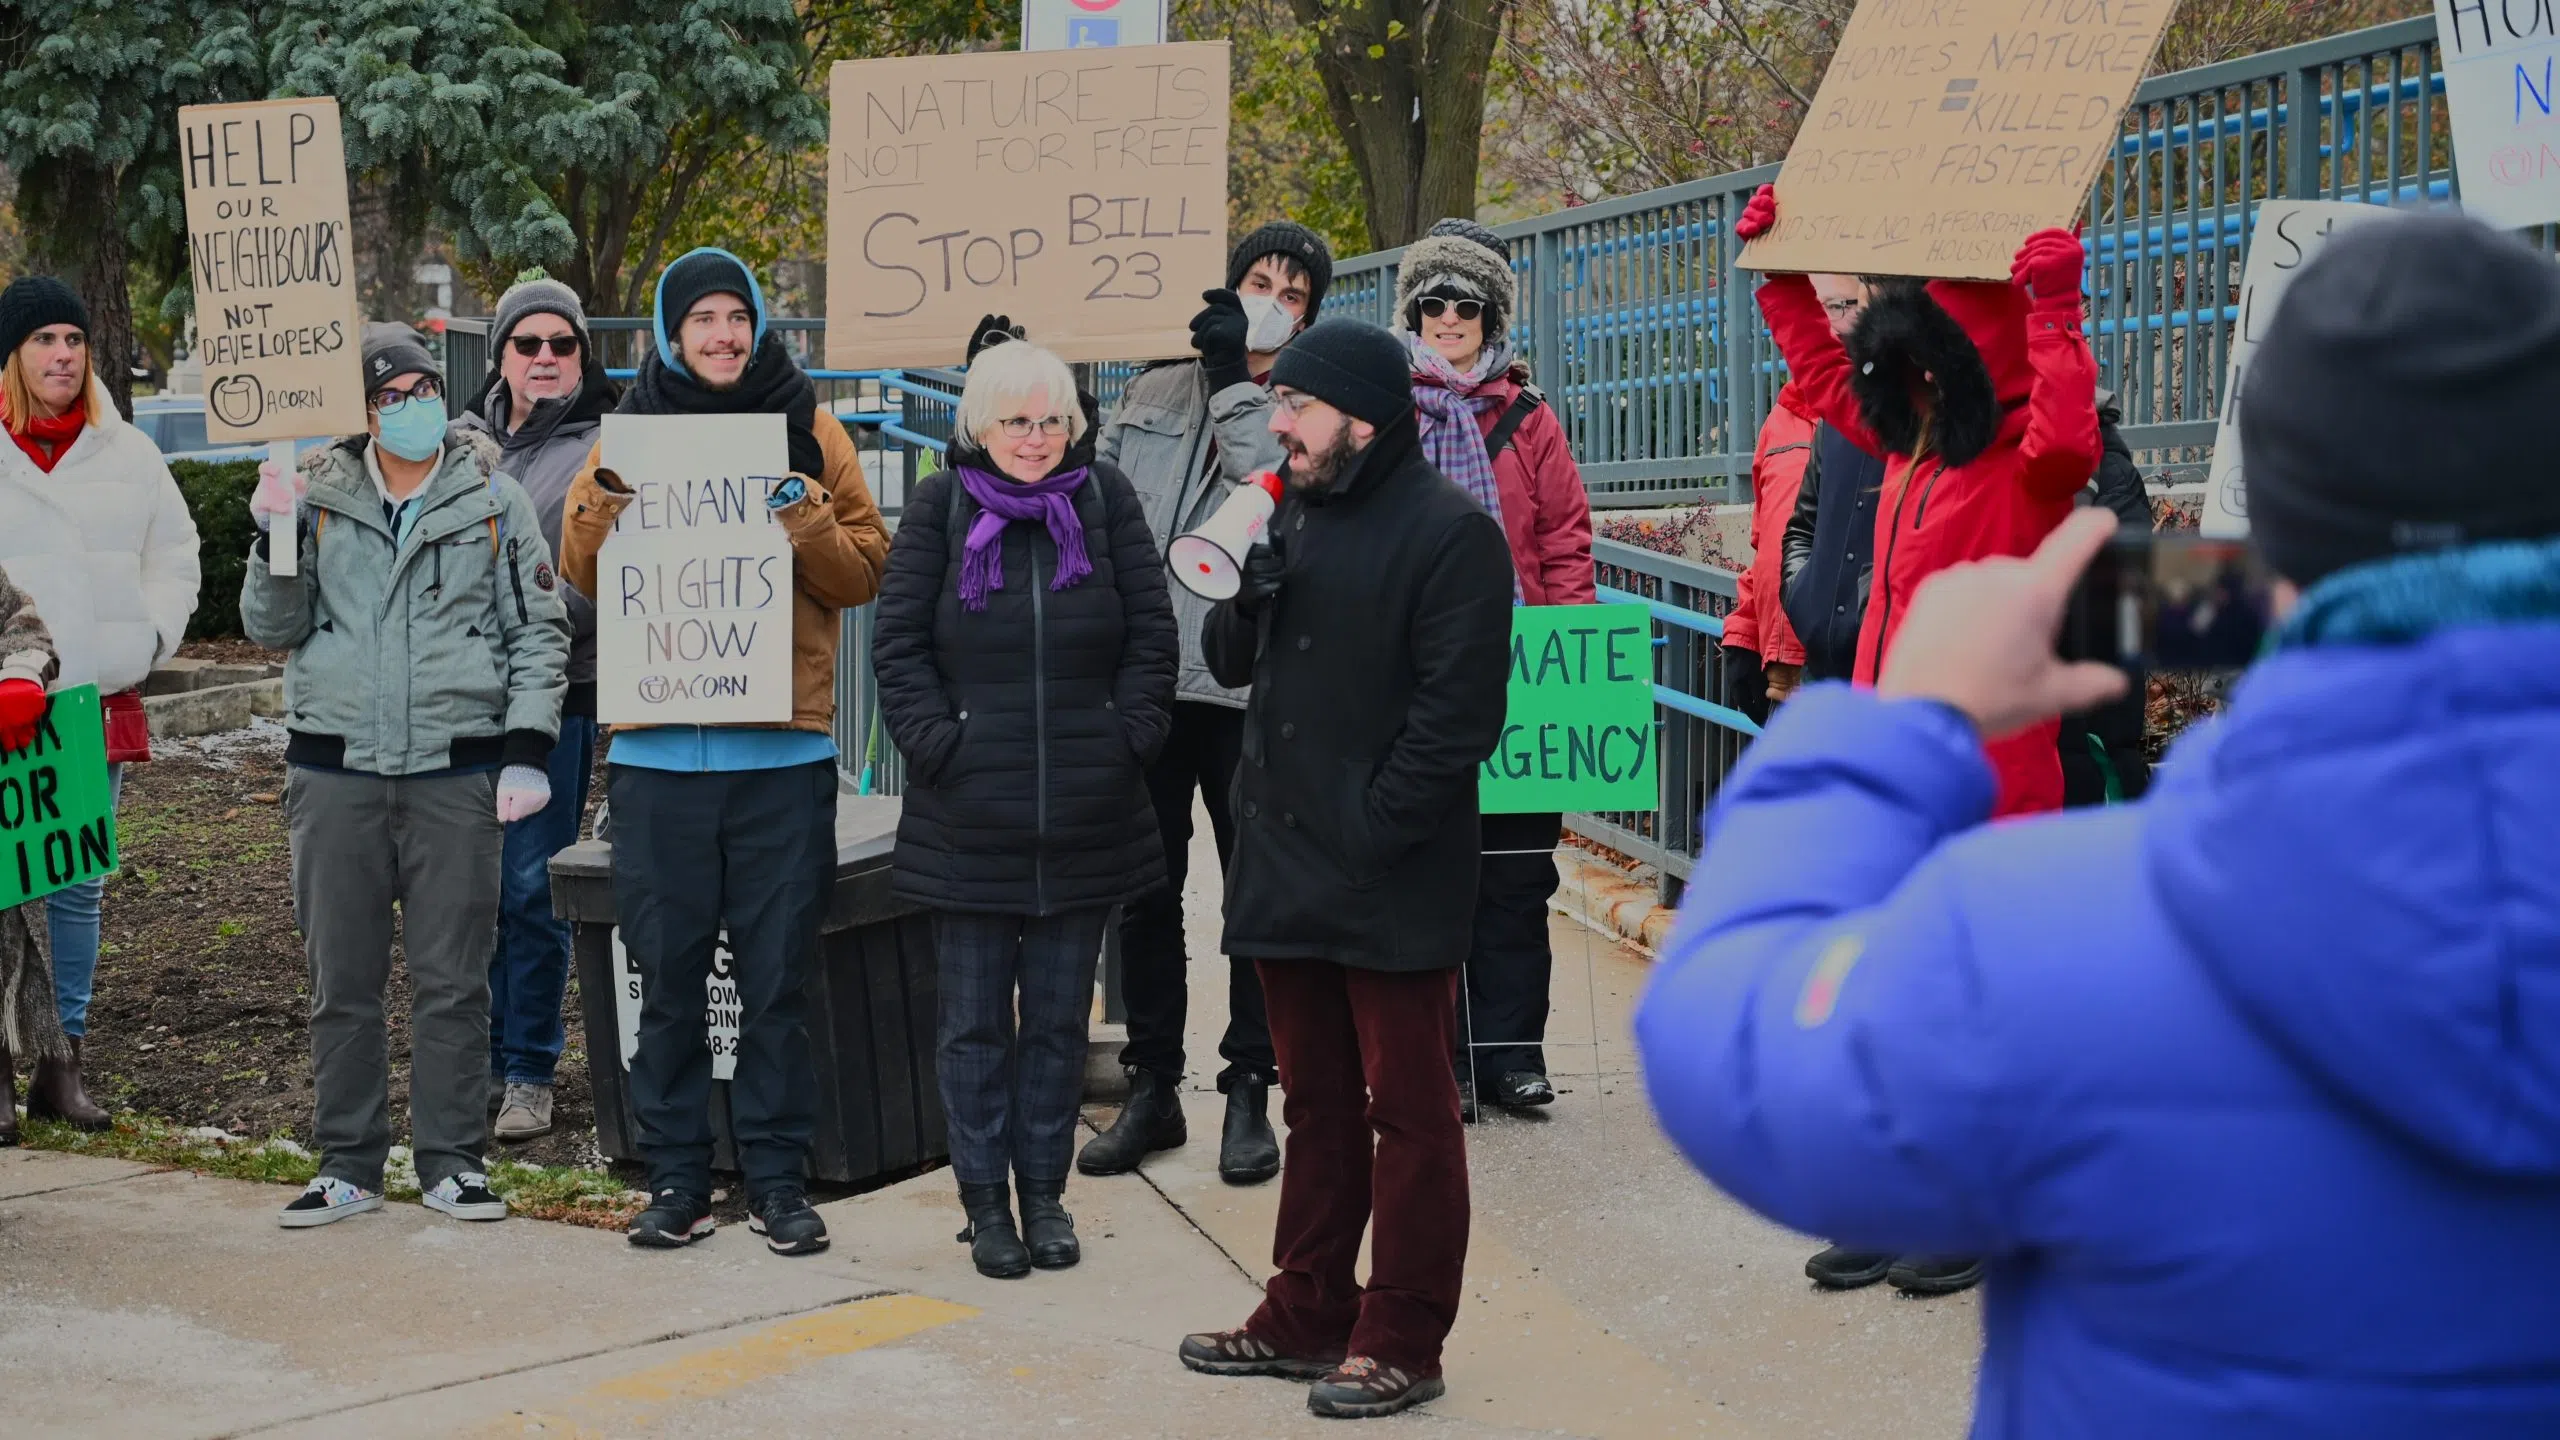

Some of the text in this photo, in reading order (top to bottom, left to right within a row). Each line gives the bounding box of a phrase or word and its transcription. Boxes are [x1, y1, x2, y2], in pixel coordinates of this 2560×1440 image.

[2450, 0, 2554, 53] HO
[1827, 41, 1959, 85] HOMES
[1977, 31, 2150, 74] NATURE
[867, 64, 1210, 139] NATURE IS
[1822, 96, 1928, 132] BUILT
[1961, 92, 2110, 135] KILLED
[187, 113, 315, 189] HELP
[844, 125, 1218, 184] NOT FOR FREE
[1930, 141, 2104, 189] FASTER!
[217, 197, 279, 219] OUR
[1804, 214, 1866, 241] STILL
[1872, 214, 1911, 241] NO
[191, 220, 343, 294] NEIGHBOURS
[863, 193, 1212, 317] STOP BILL
[1926, 238, 2015, 263] HOUSIN
[1084, 251, 1163, 301] 23
[223, 303, 273, 330] NOT
[203, 320, 343, 367] DEVELOPERS
[267, 387, 323, 414] ACORN
[615, 476, 783, 533] ENANT
[622, 556, 777, 616] RIGHTS
[647, 618, 757, 664] NOW
[670, 674, 748, 699] ACORN
